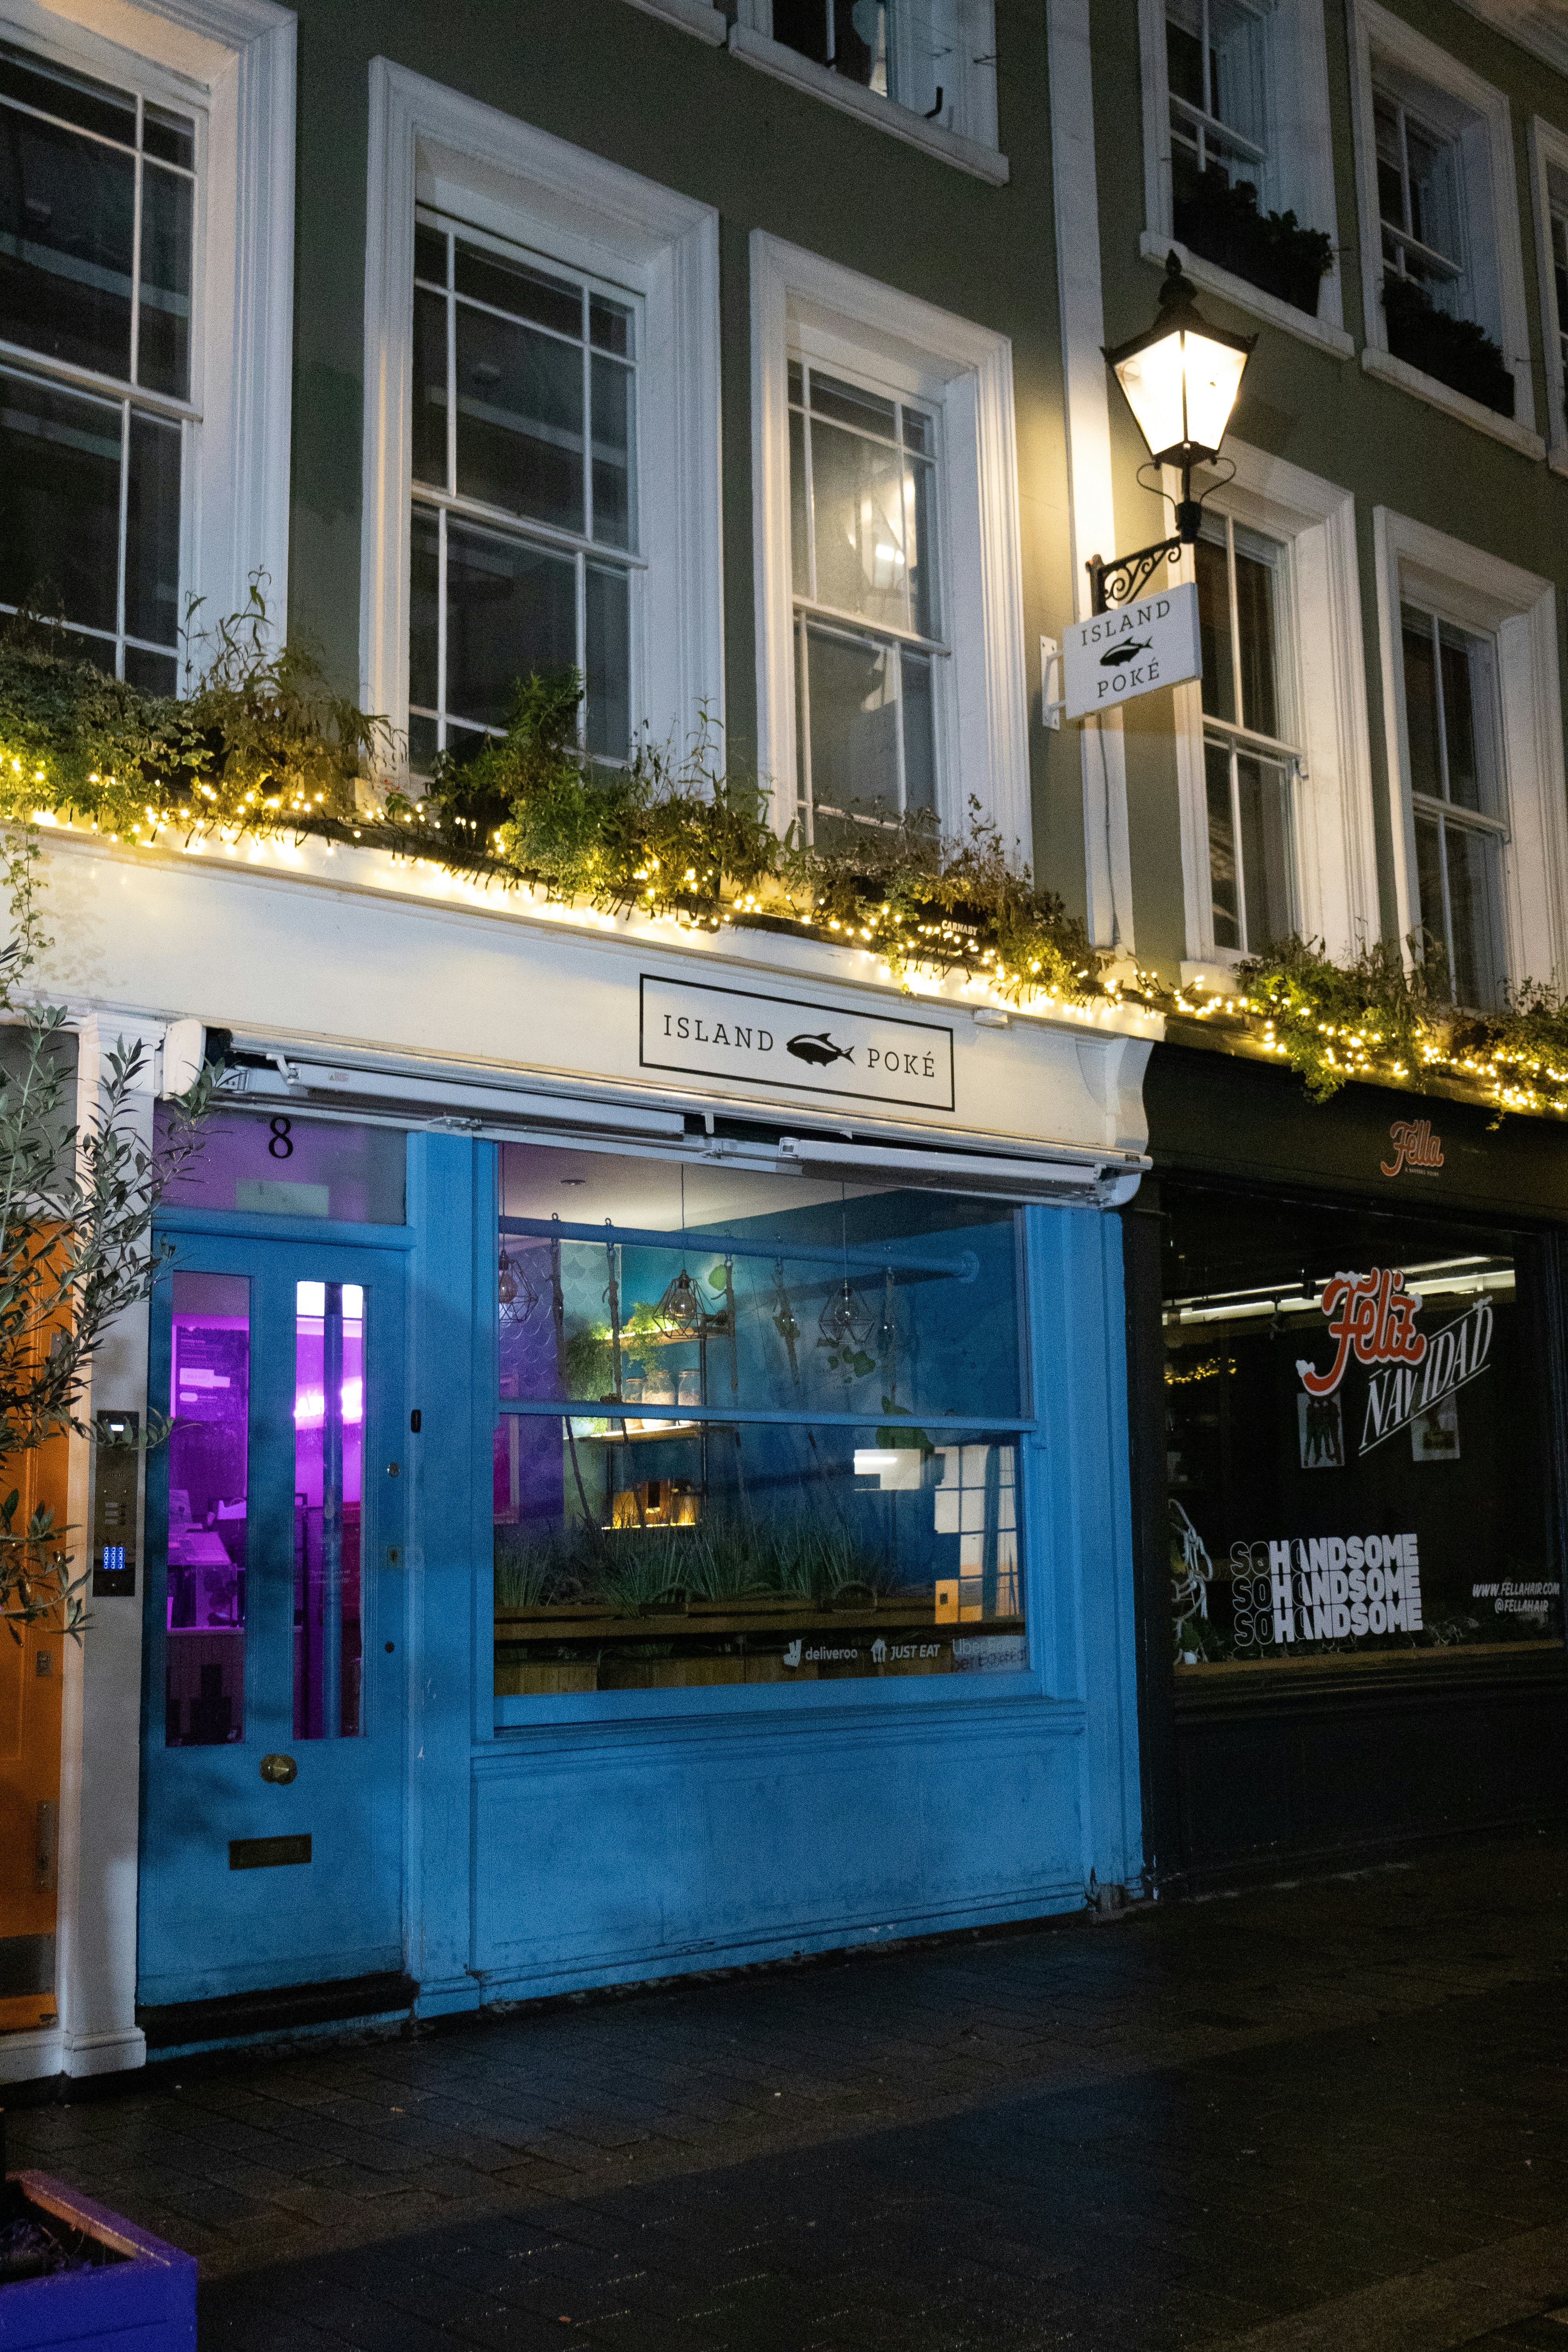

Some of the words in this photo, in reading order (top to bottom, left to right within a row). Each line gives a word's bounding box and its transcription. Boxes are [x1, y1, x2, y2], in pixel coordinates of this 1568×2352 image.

[1081, 601, 1171, 646] ISLAND
[1097, 658, 1159, 698] POKÉ
[941, 920, 978, 936] CARNABY
[664, 1014, 773, 1051] ISLAND
[867, 1049, 935, 1077] POKÉ
[269, 1116, 293, 1159] 8
[1380, 1120, 1445, 1176] Fella
[1296, 1267, 1428, 1396] Feliz
[1359, 1305, 1493, 1450] NAVIDAD
[1472, 1582, 1560, 1598] WWW.FELLAHAIR.COM
[1494, 1597, 1549, 1614] @FELLAHAIR
[805, 1646, 858, 1661] deliveroo
[890, 1645, 917, 1661] JUST
[919, 1644, 941, 1657] EAT
[952, 1638, 986, 1655] Uber
